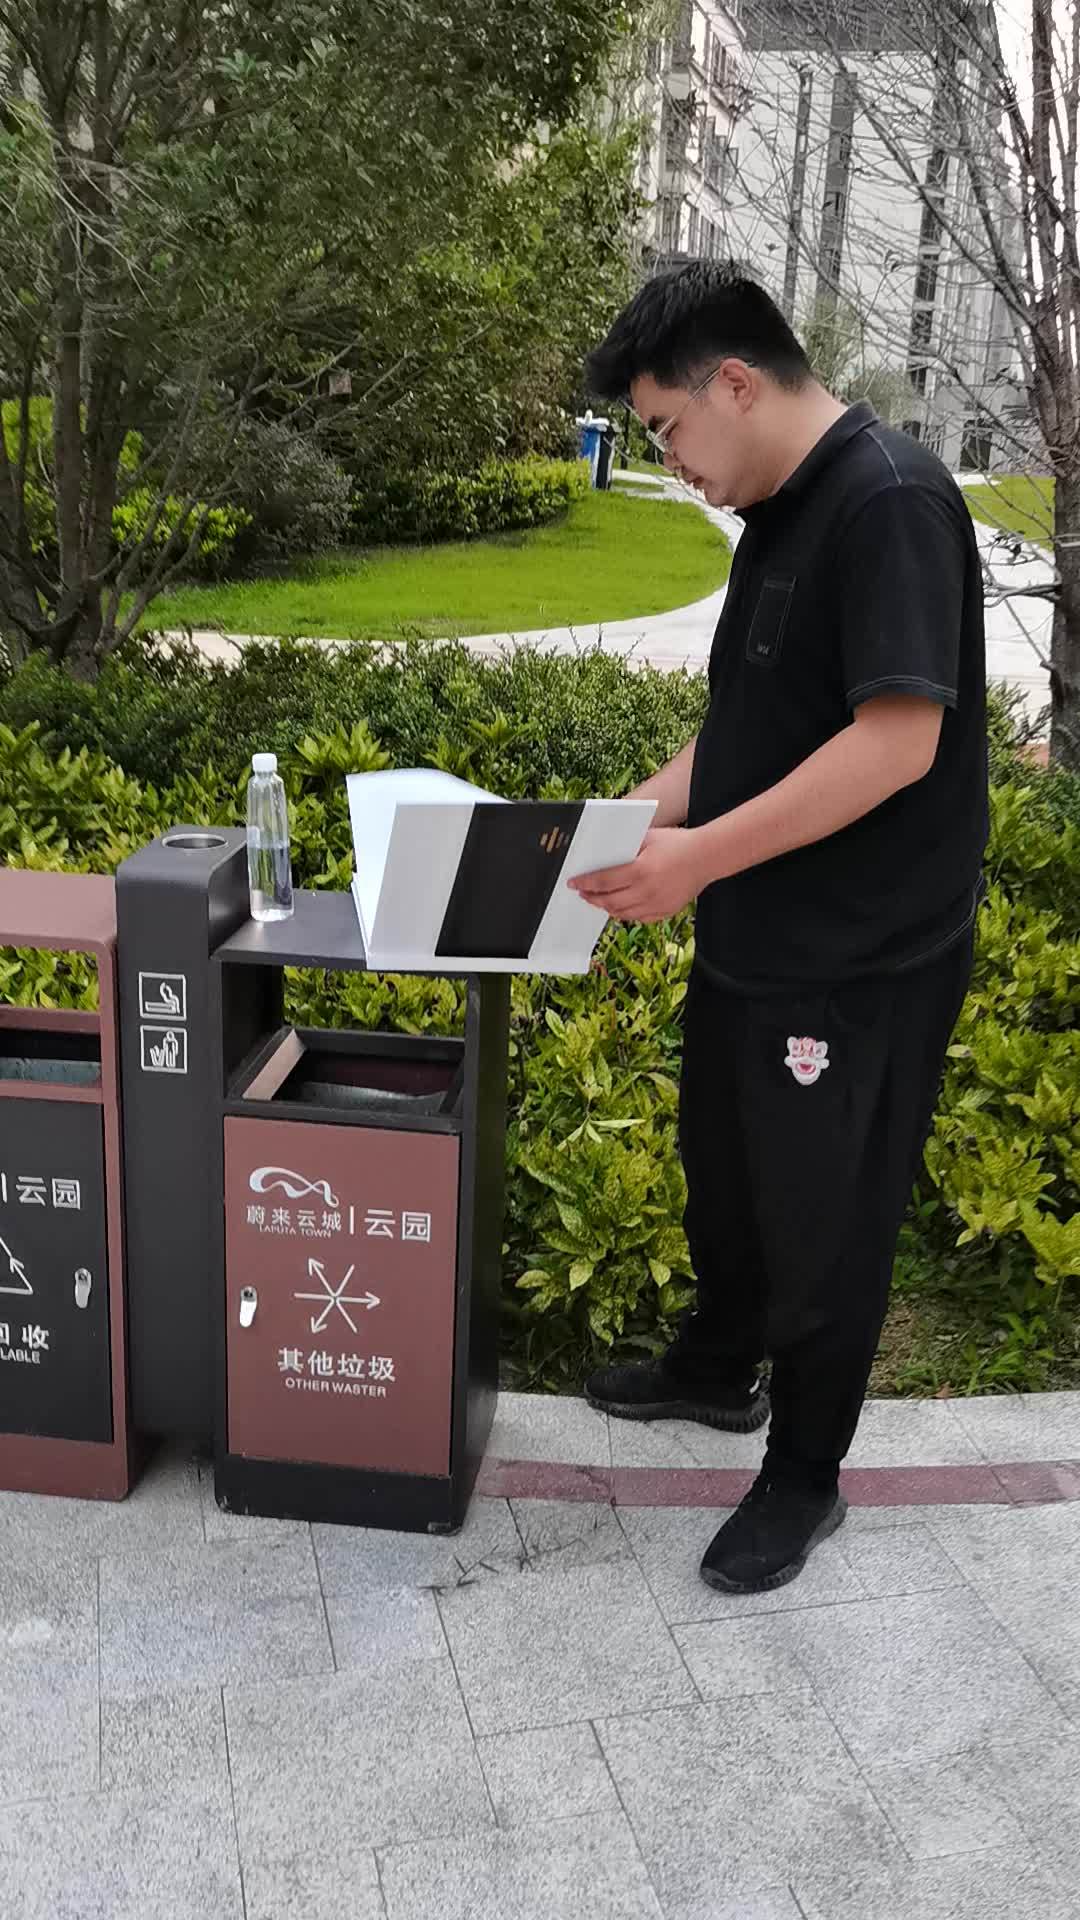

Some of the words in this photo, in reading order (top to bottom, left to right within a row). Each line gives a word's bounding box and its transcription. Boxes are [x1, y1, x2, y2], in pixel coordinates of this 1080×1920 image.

[15, 1175, 81, 1210] 云园
[246, 1204, 342, 1232] 蔚来云城
[259, 1223, 297, 1235] LAPUTA
[301, 1227, 332, 1238] TOWN
[364, 1207, 431, 1243] 云园
[277, 1347, 396, 1382] 其他垃圾
[285, 1377, 330, 1392] OTHER
[331, 1381, 386, 1398] WASTER
